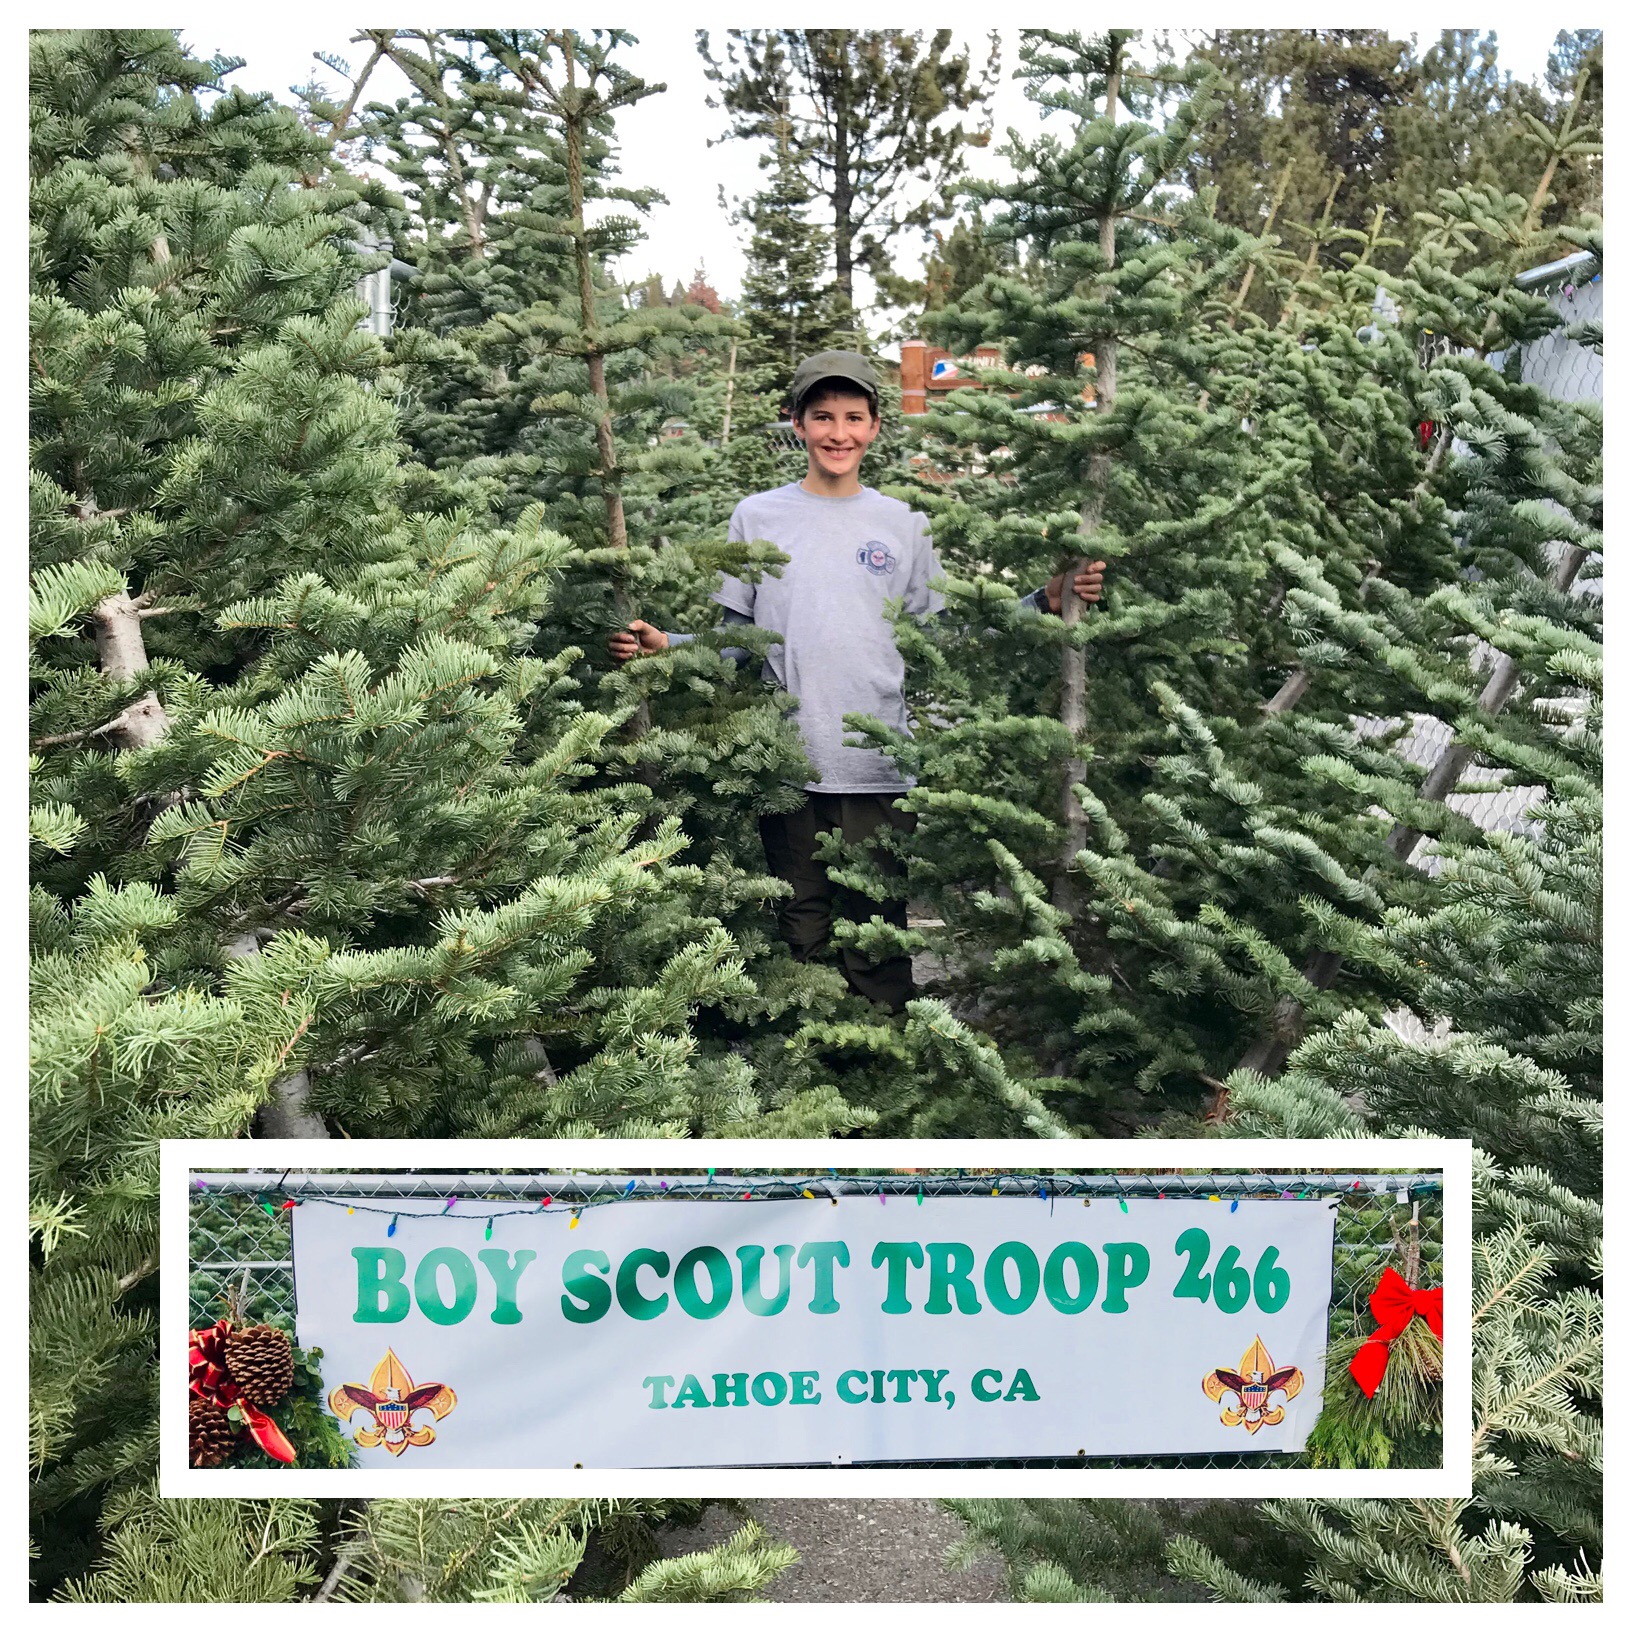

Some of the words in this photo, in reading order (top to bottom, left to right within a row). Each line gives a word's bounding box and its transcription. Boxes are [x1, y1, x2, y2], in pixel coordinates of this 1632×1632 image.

[351, 1246, 537, 1327] BOY
[560, 1240, 851, 1325] SCOUT
[871, 1240, 1151, 1316] TROOP
[1173, 1227, 1292, 1315] 266
[642, 1370, 823, 1410] TAHOE
[835, 1368, 956, 1411] CITY,
[970, 1367, 1042, 1403] CA
